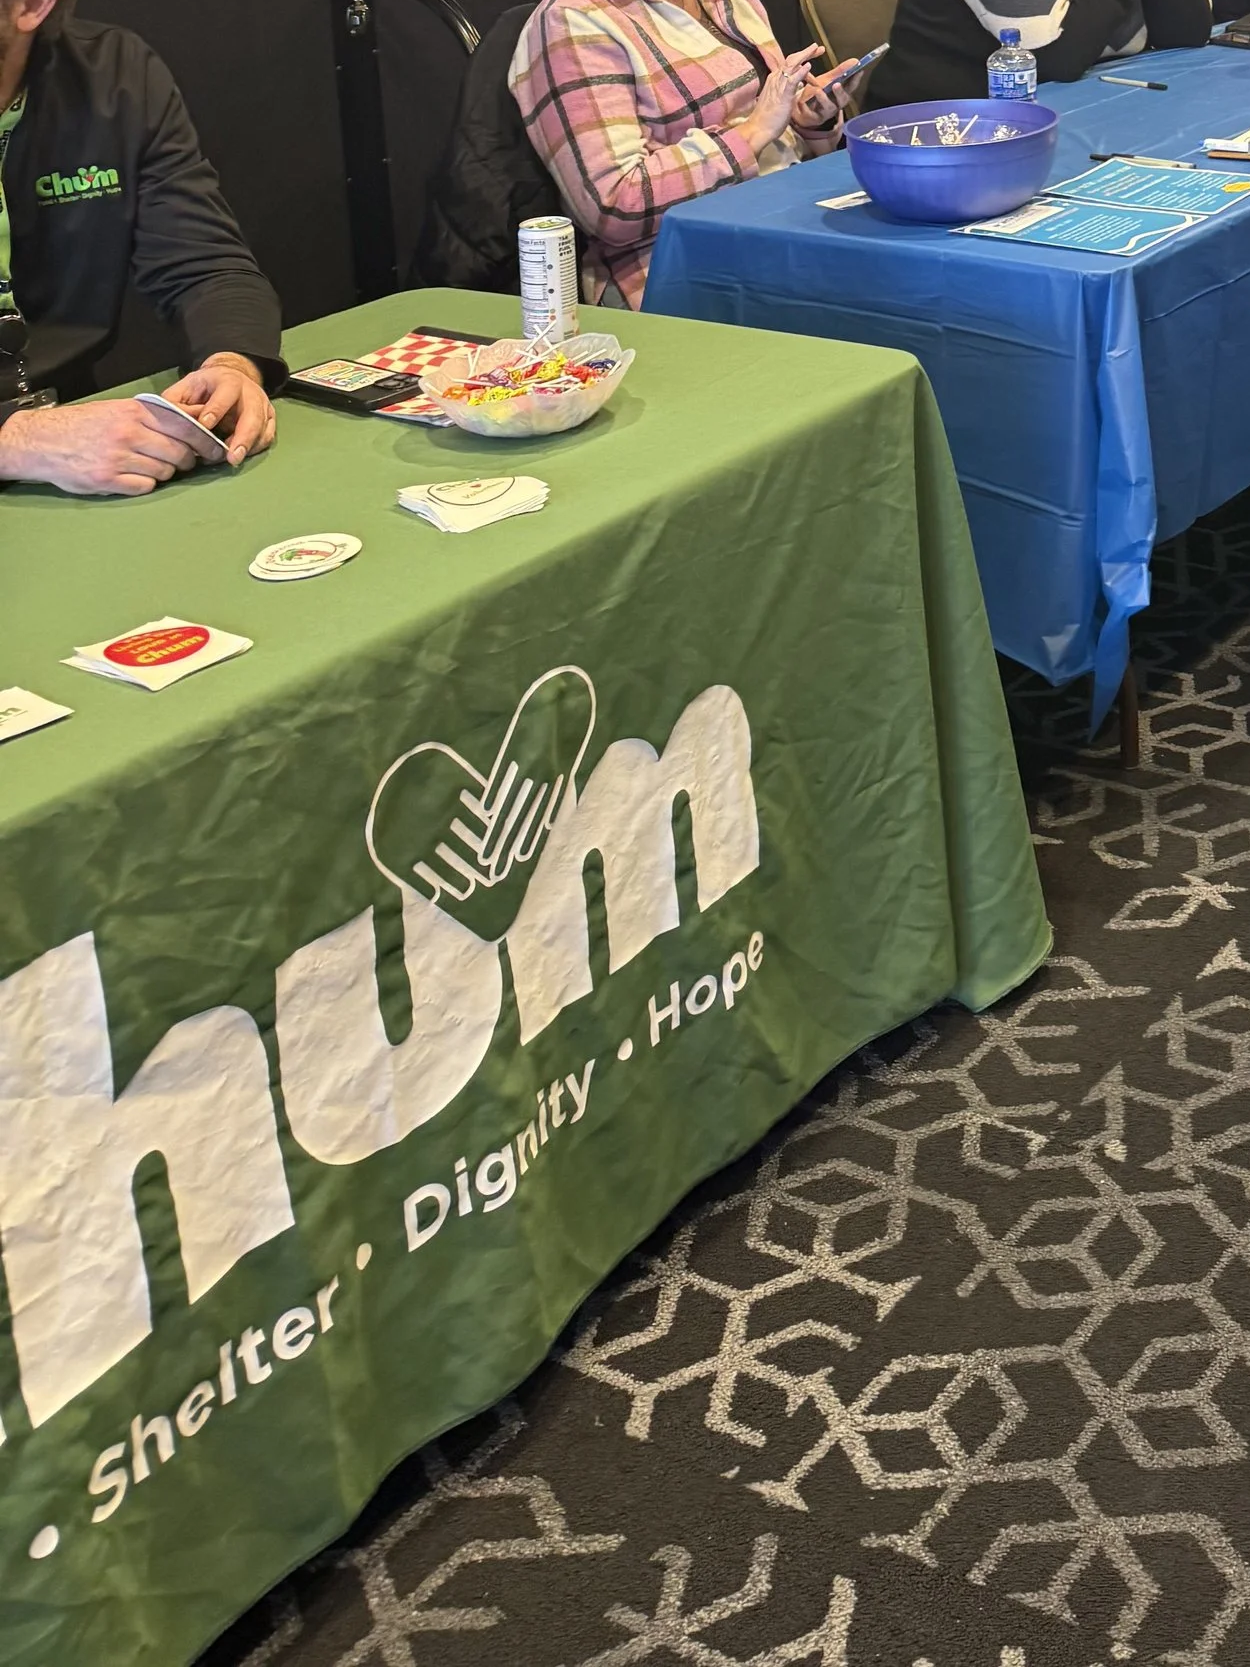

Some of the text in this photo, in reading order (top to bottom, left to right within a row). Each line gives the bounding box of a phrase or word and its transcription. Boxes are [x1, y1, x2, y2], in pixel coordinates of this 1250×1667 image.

[0, 684, 760, 1428] hum
[86, 929, 766, 1524] Shelter Dignity Hope
